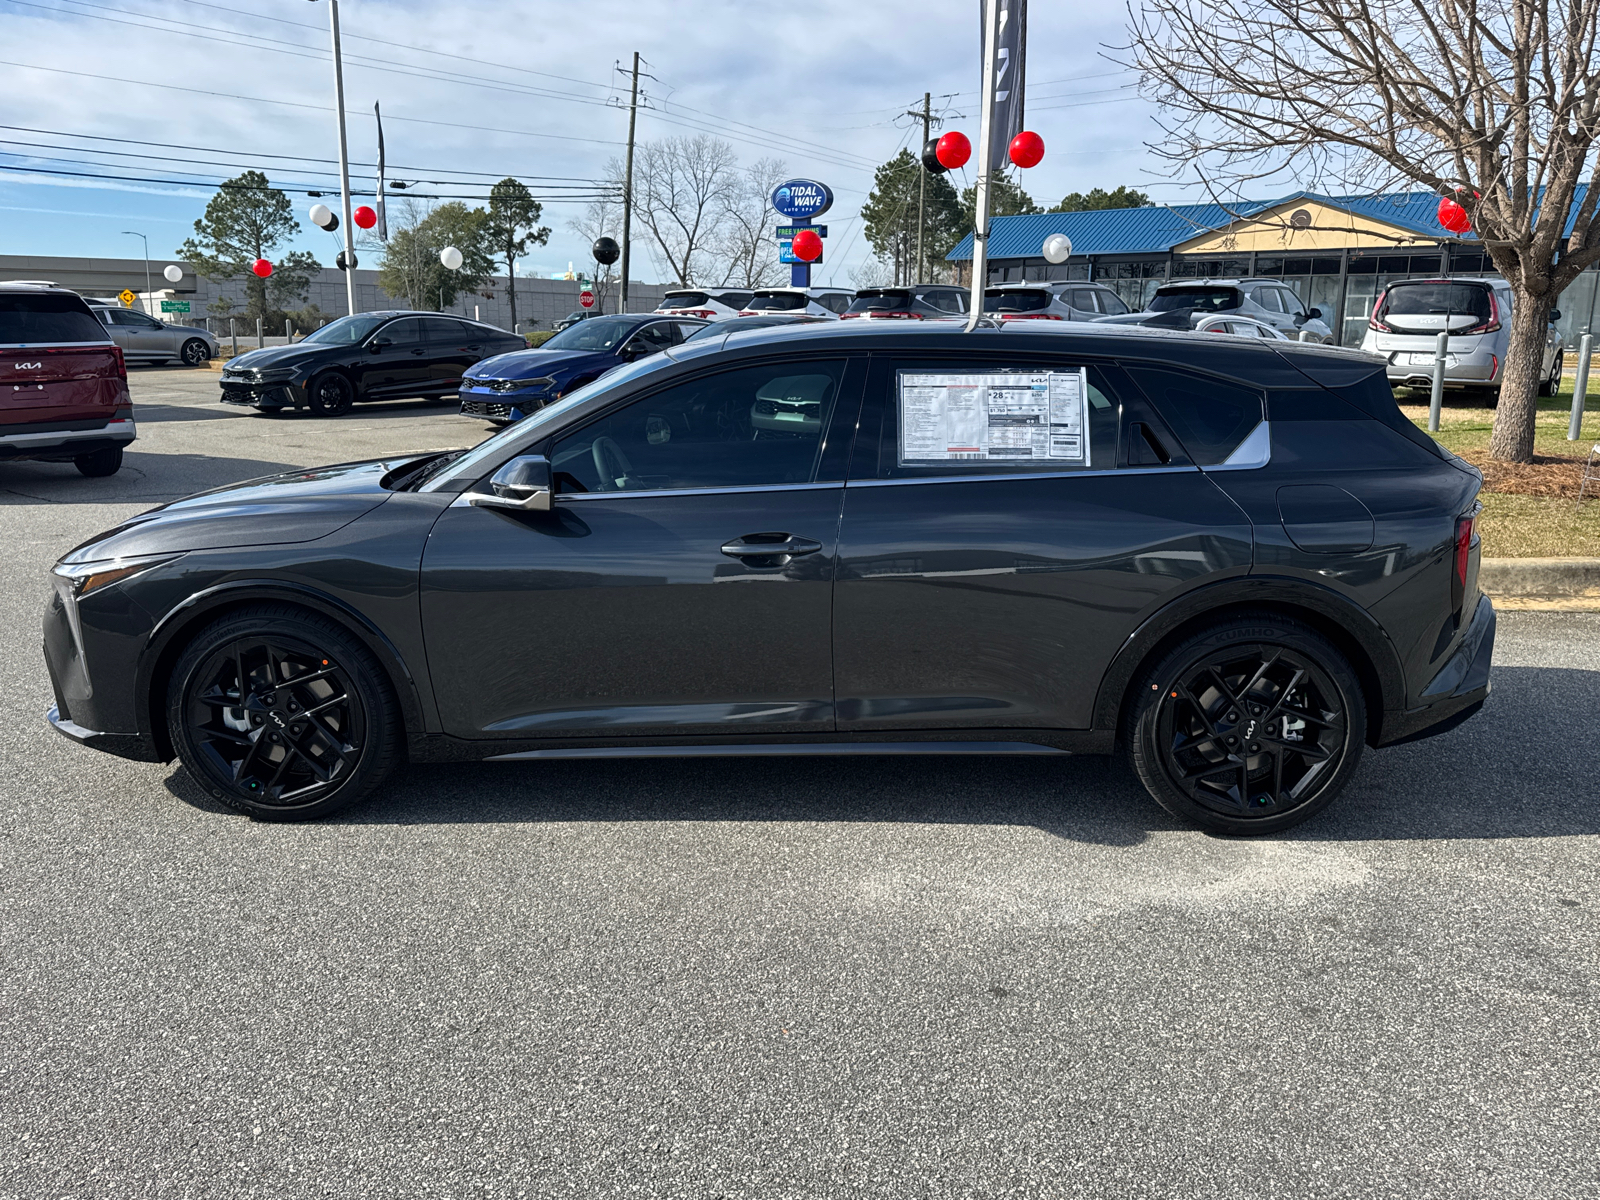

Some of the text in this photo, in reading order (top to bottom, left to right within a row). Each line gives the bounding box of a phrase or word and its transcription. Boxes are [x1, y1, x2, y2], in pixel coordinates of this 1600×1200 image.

[790, 186, 817, 196] TIDAL
[794, 196, 822, 206] WAVE
[14, 362, 42, 370] KIA
[993, 391, 1004, 399] 28
[1215, 628, 1275, 642] KUMHO
